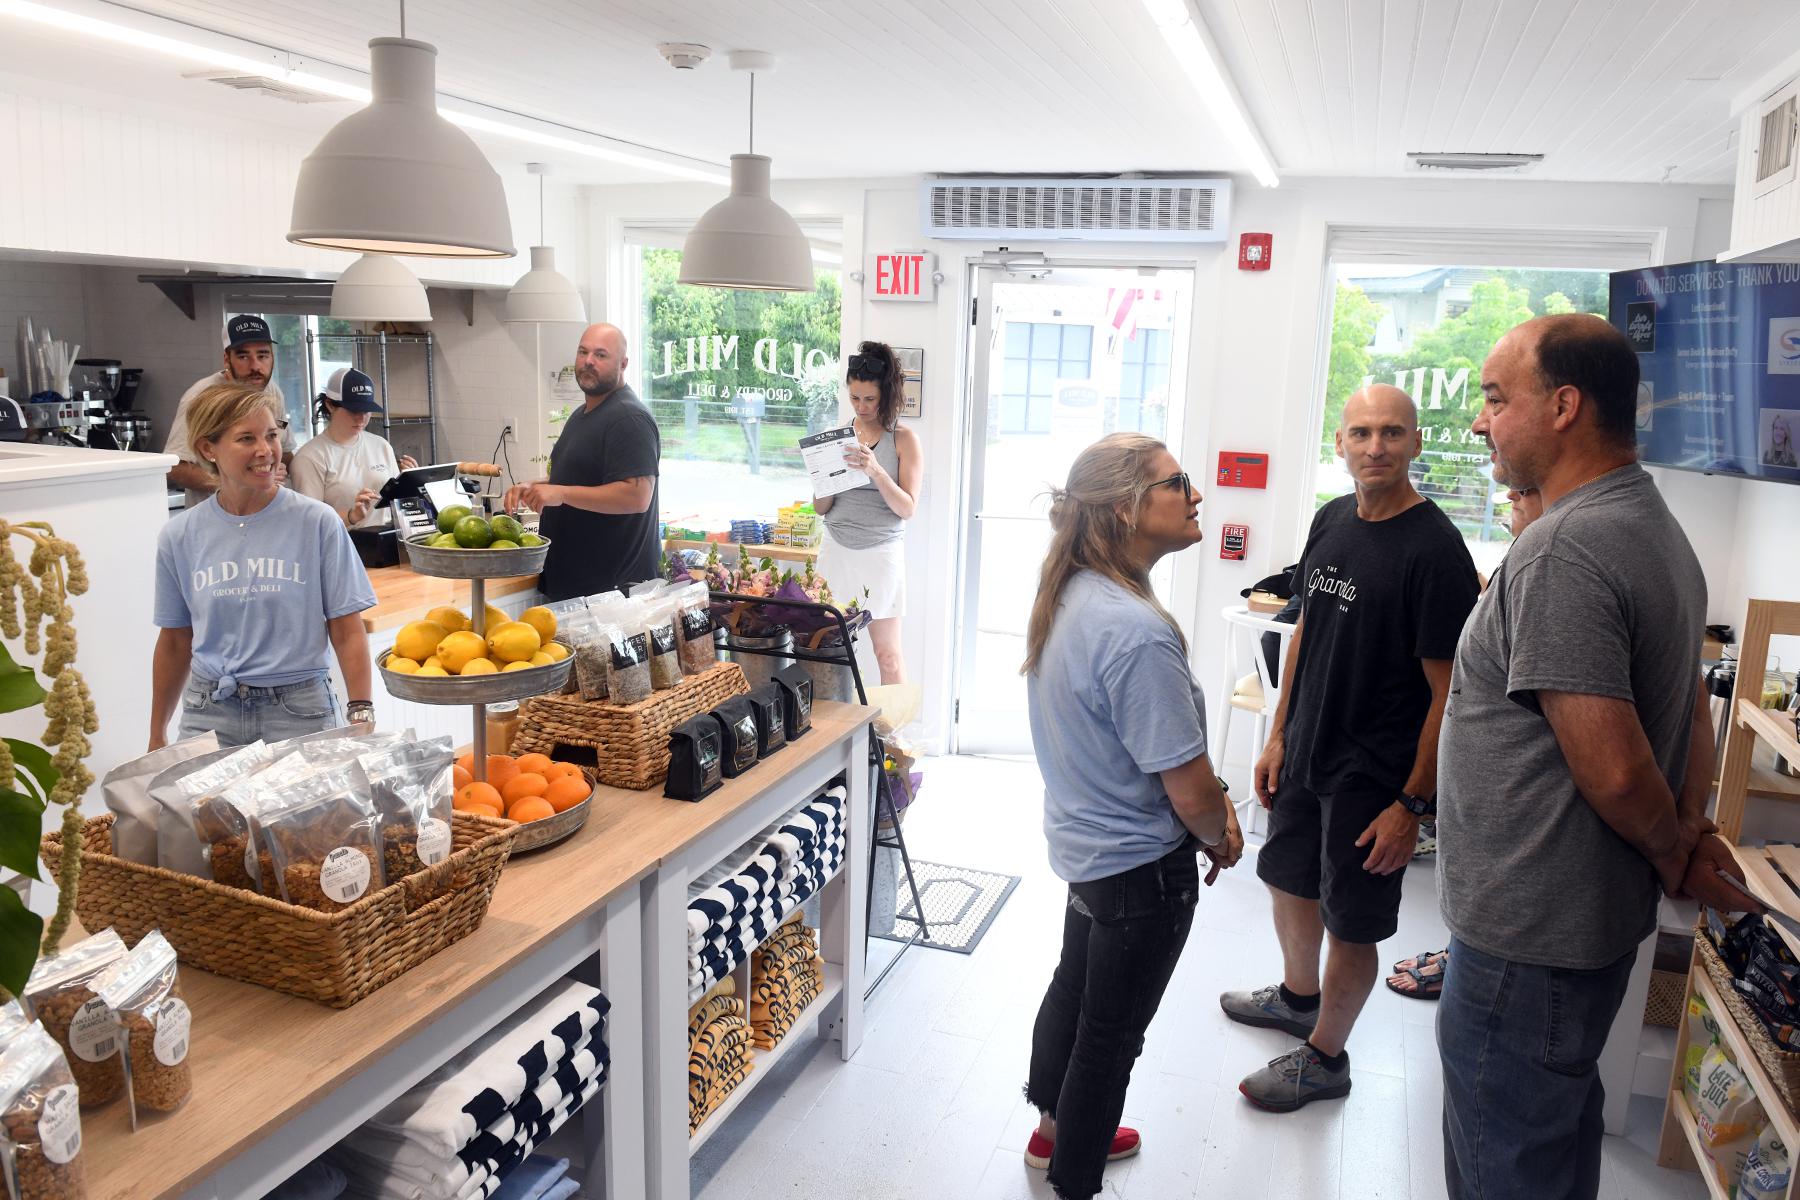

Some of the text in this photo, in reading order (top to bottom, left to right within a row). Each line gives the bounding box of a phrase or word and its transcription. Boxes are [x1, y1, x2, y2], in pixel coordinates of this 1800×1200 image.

[876, 255, 923, 294] EXIT
[1636, 274, 1676, 297] DONATED
[1678, 270, 1725, 293] SERVICES
[1737, 264, 1775, 287] THANK
[1776, 262, 1800, 284] YOU
[235, 322, 249, 332] OLD
[1225, 527, 1245, 536] FIRE
[192, 557, 306, 593] OLD MILL
[250, 585, 258, 593] &
[260, 584, 281, 592] DELI
[1308, 568, 1357, 602] Granola
[1708, 1063, 1736, 1093] LATE
[1702, 1083, 1730, 1110] JULY
[1756, 1168, 1775, 1190] CORN
